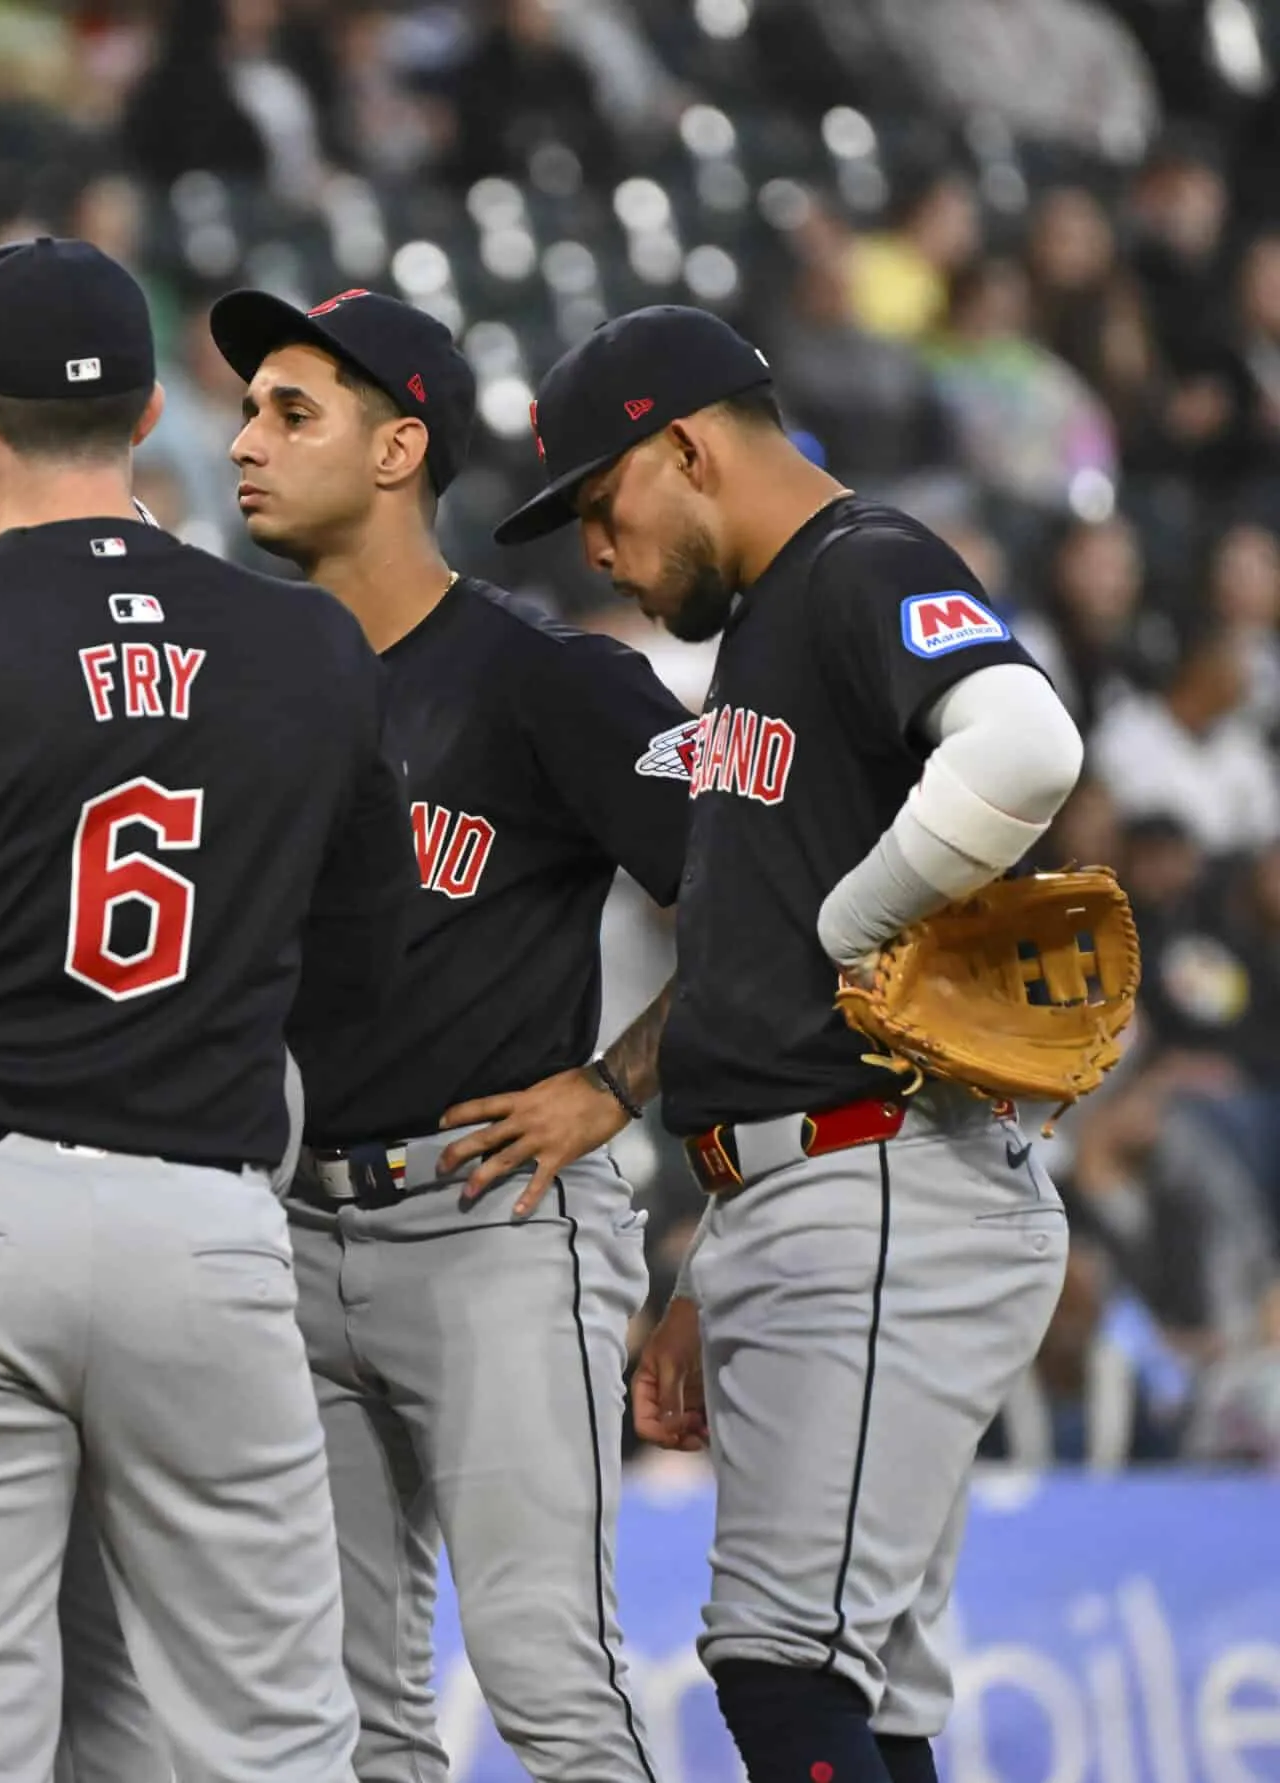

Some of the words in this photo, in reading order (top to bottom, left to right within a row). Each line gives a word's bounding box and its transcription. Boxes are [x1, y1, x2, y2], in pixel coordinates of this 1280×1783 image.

[917, 599, 990, 638] M
[78, 643, 206, 722] FRY
[64, 775, 204, 1002] 6
